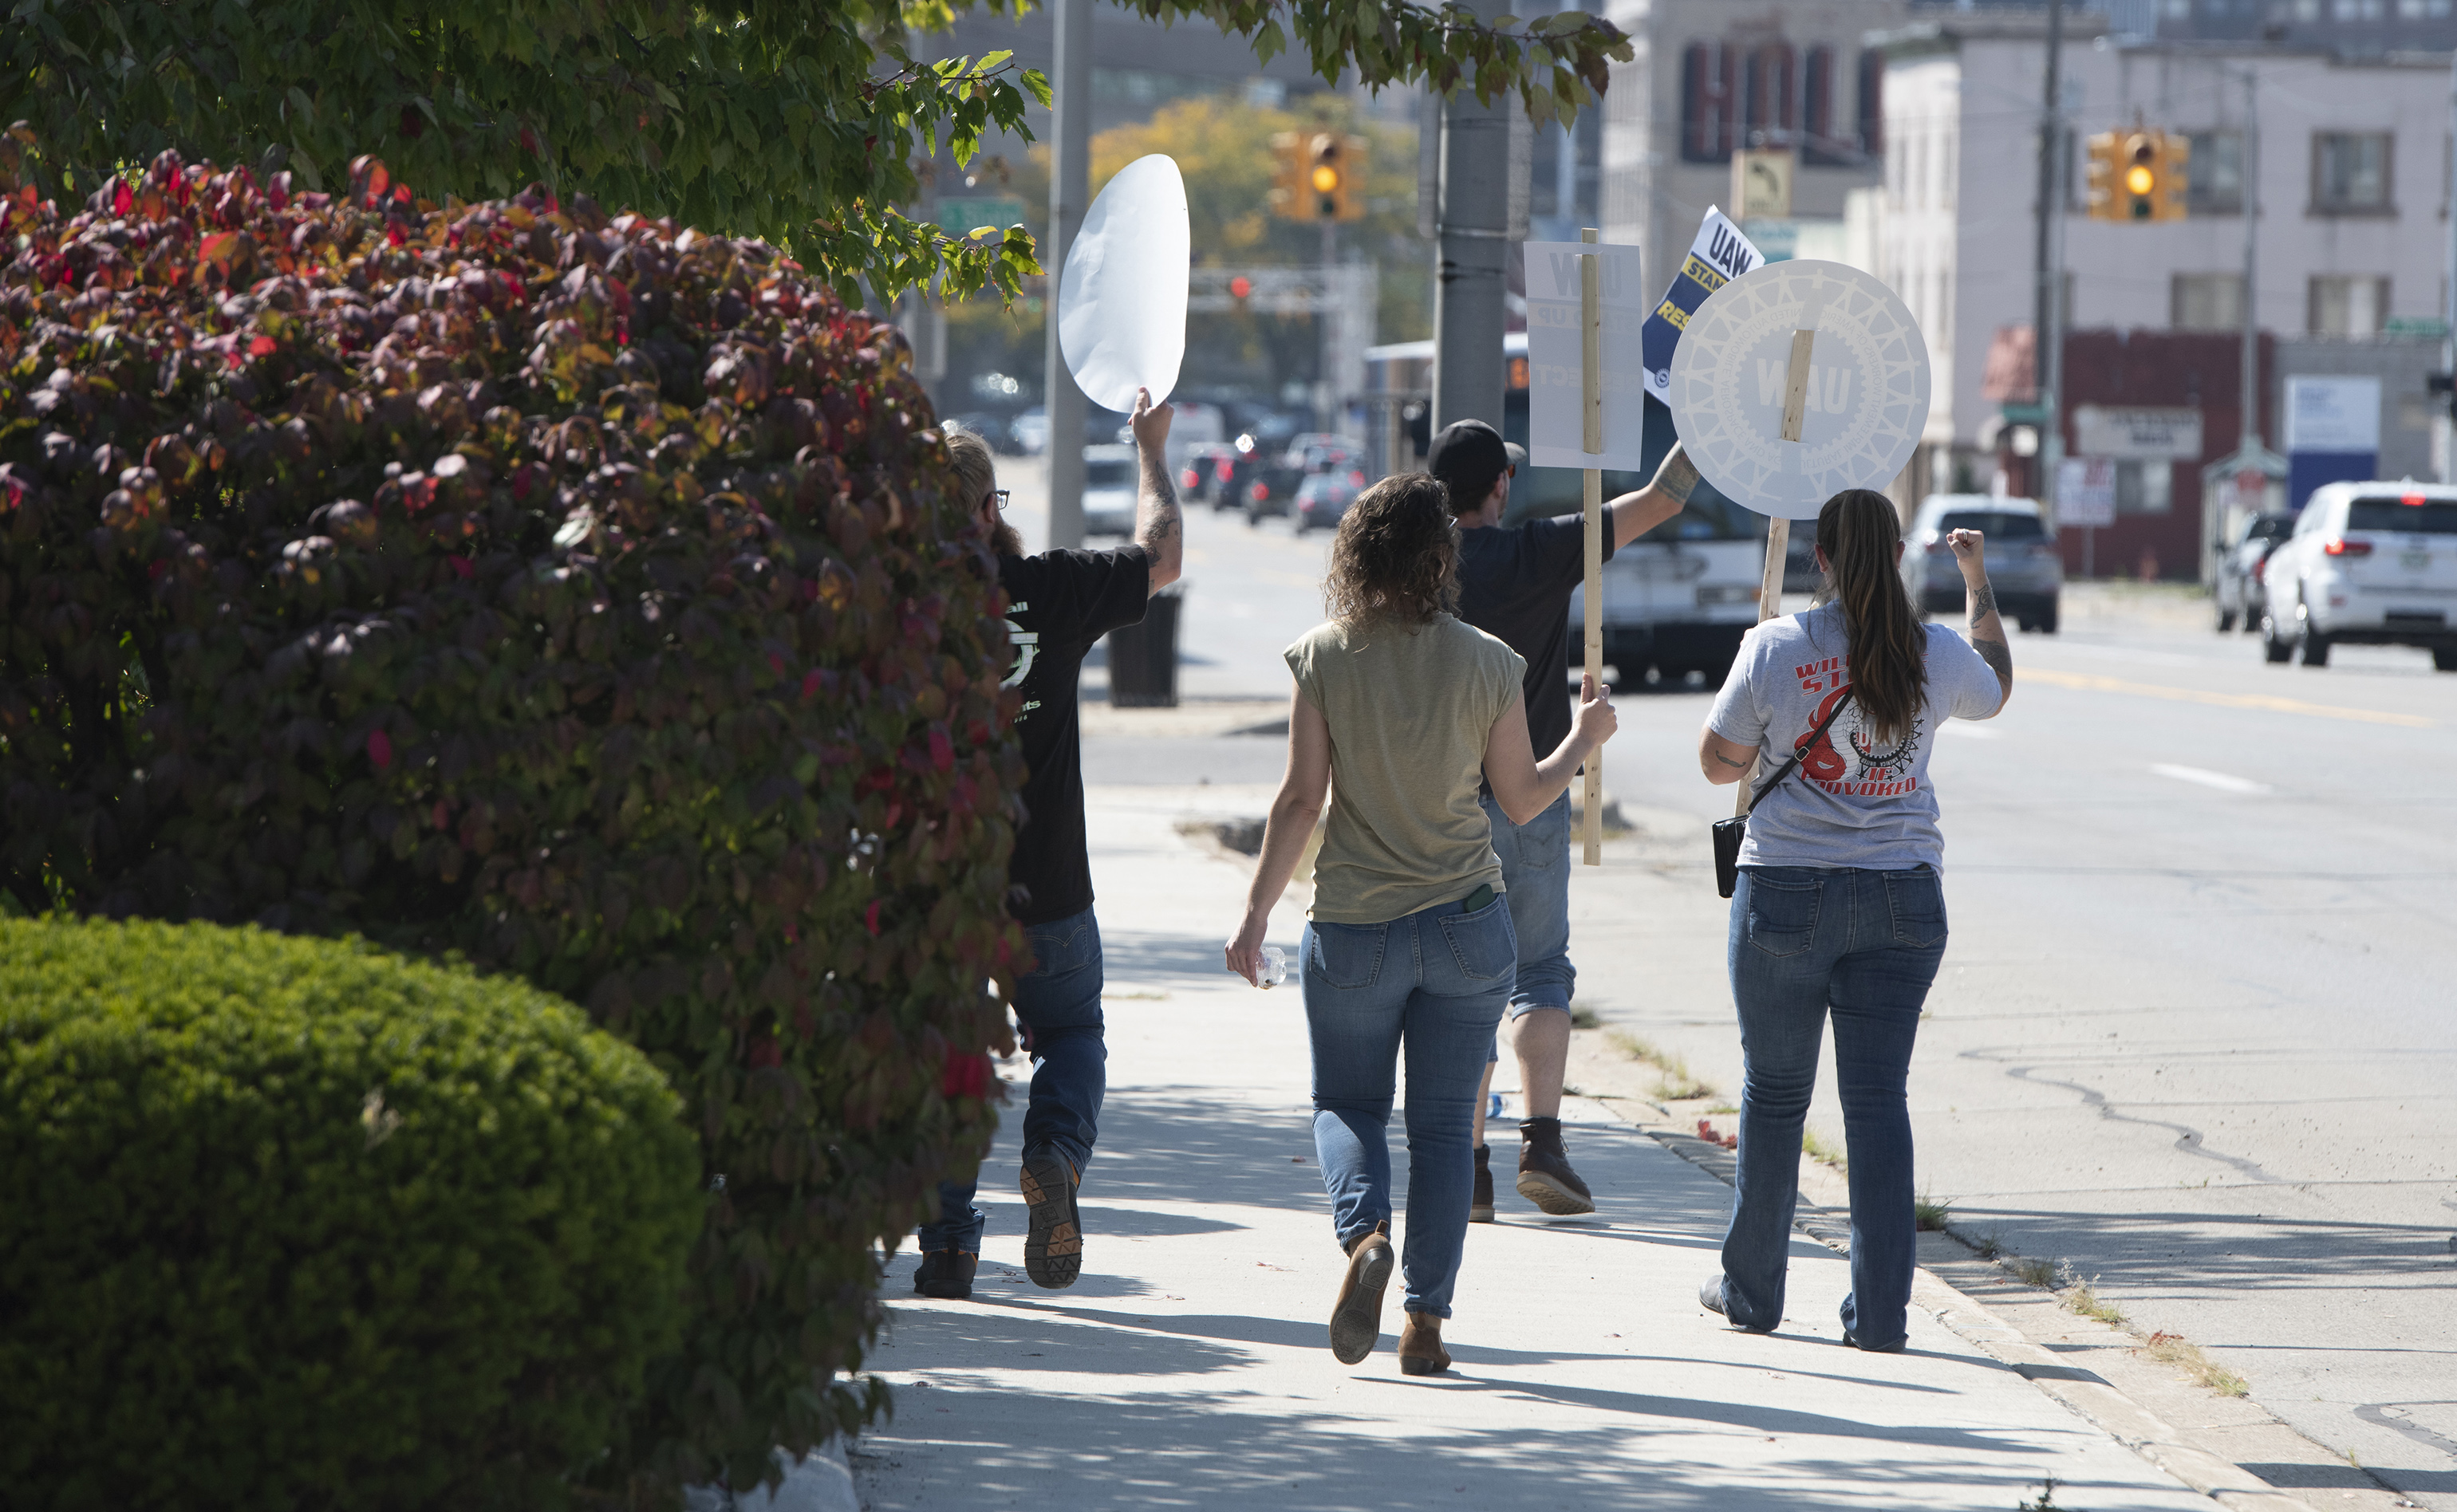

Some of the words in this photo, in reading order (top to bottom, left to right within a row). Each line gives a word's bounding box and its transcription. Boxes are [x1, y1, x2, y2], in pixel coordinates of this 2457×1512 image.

[1710, 222, 1753, 279] UAW
[1795, 654, 1850, 679] WIL
[1867, 767, 1893, 781] IF
